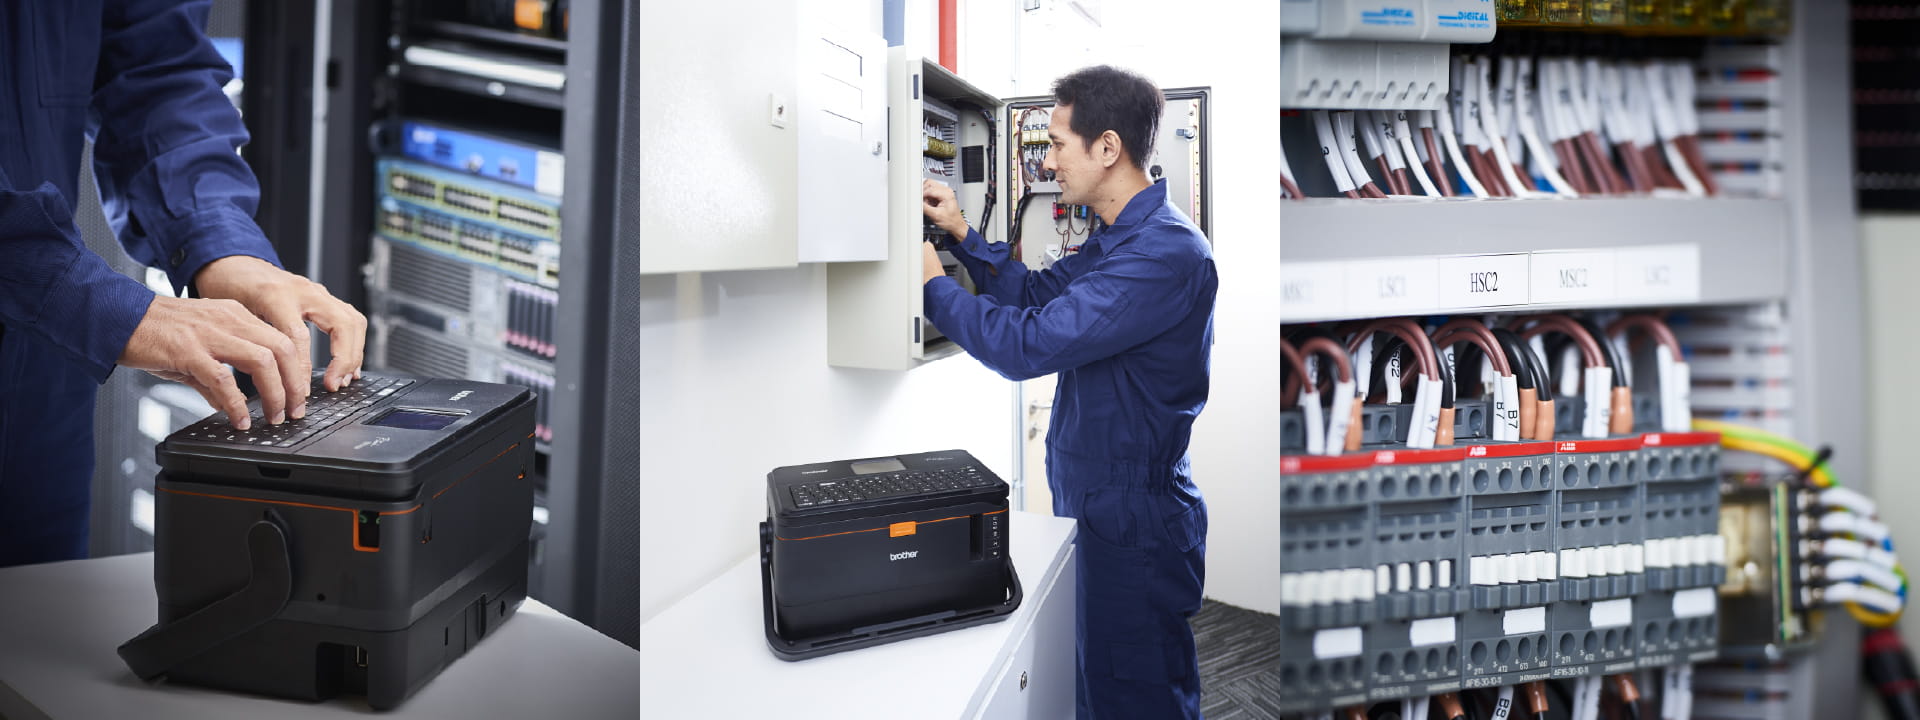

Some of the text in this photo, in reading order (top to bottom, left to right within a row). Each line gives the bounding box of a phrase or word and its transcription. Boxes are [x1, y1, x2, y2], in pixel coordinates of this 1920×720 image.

[1457, 11, 1488, 21] DIGITAL
[1470, 272, 1499, 293] HSC2
[1559, 268, 1588, 289] MSC2
[1508, 410, 1518, 429] B7
[1469, 446, 1487, 457] ABB
[1560, 442, 1576, 451] ABB
[889, 550, 919, 561] brother
